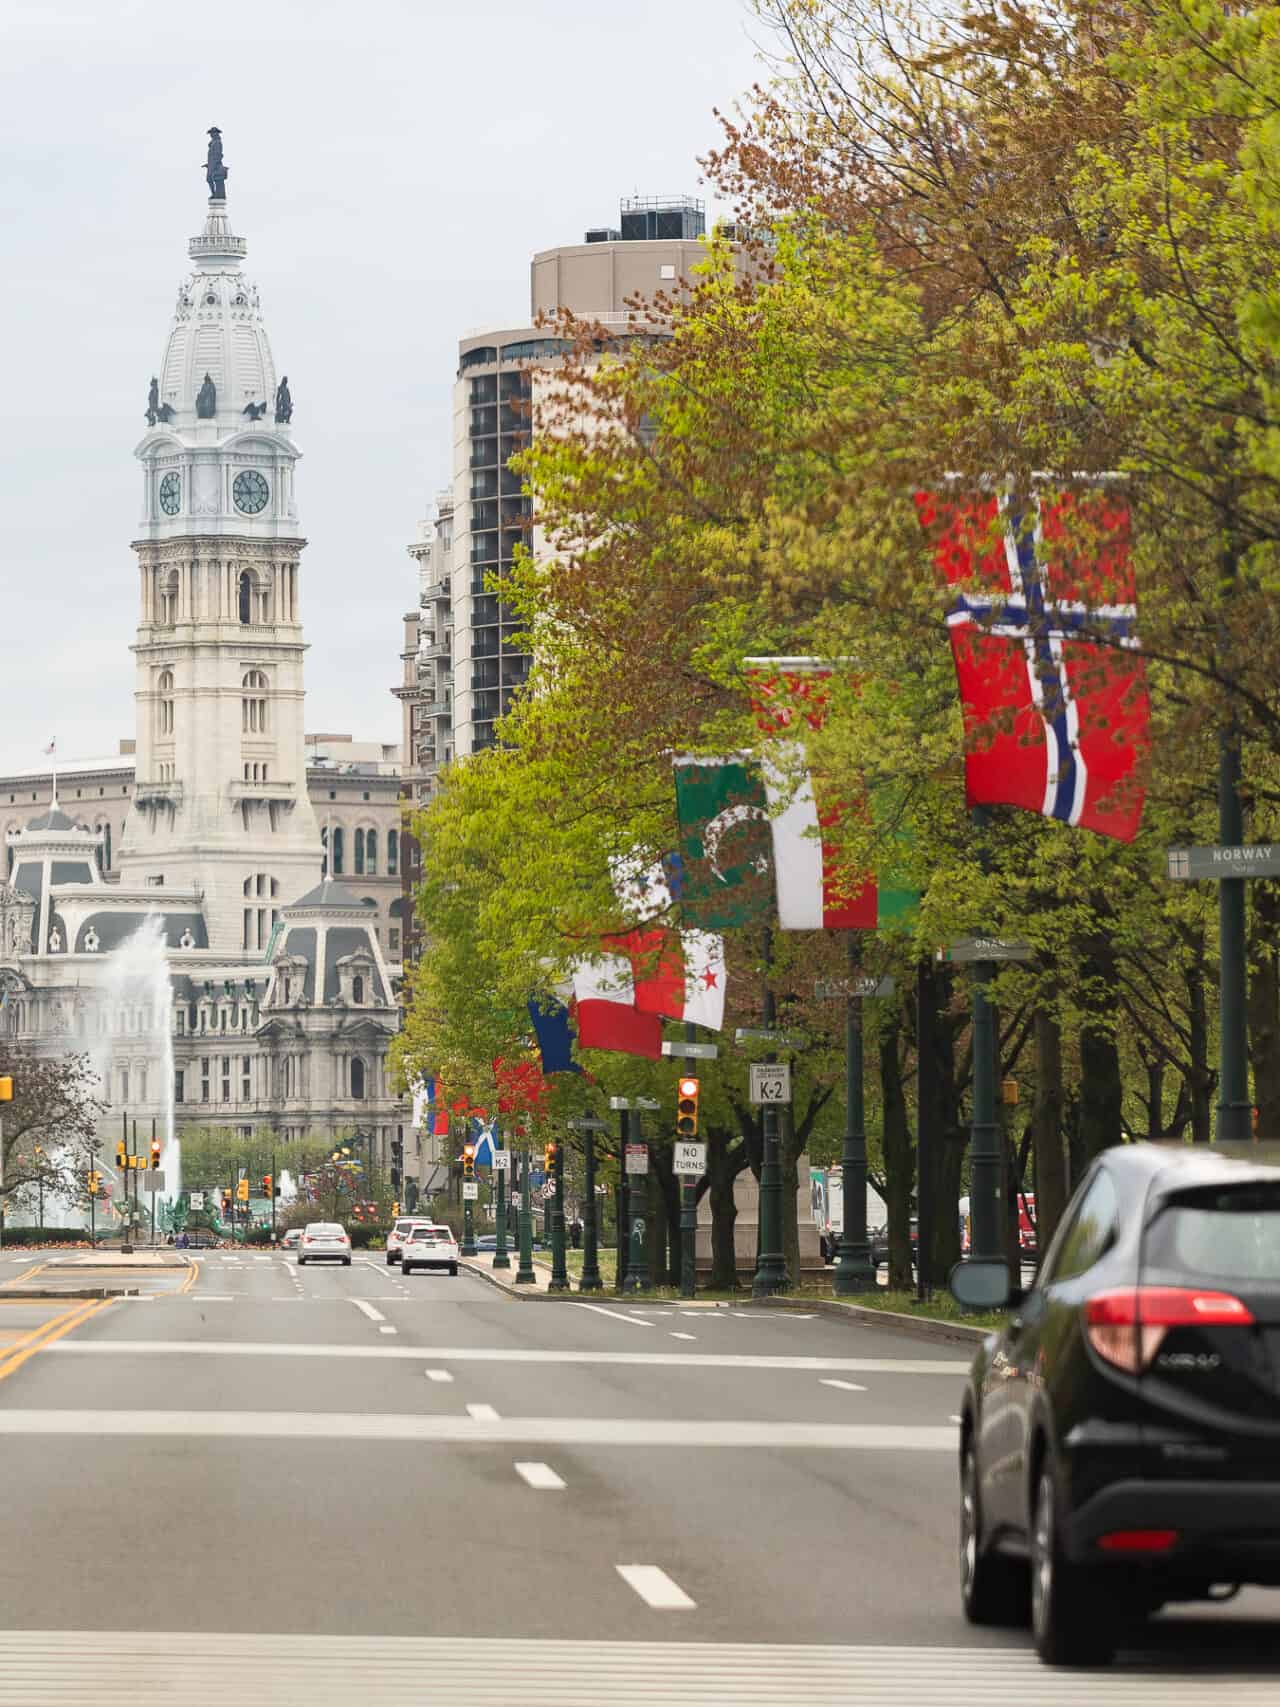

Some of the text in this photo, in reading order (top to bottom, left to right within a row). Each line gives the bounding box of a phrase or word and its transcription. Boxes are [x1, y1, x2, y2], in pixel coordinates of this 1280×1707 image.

[1213, 847, 1272, 861] NORWAY
[760, 1081, 783, 1100] K-2
[683, 1147, 697, 1157] NO
[676, 1159, 705, 1169] TURNS
